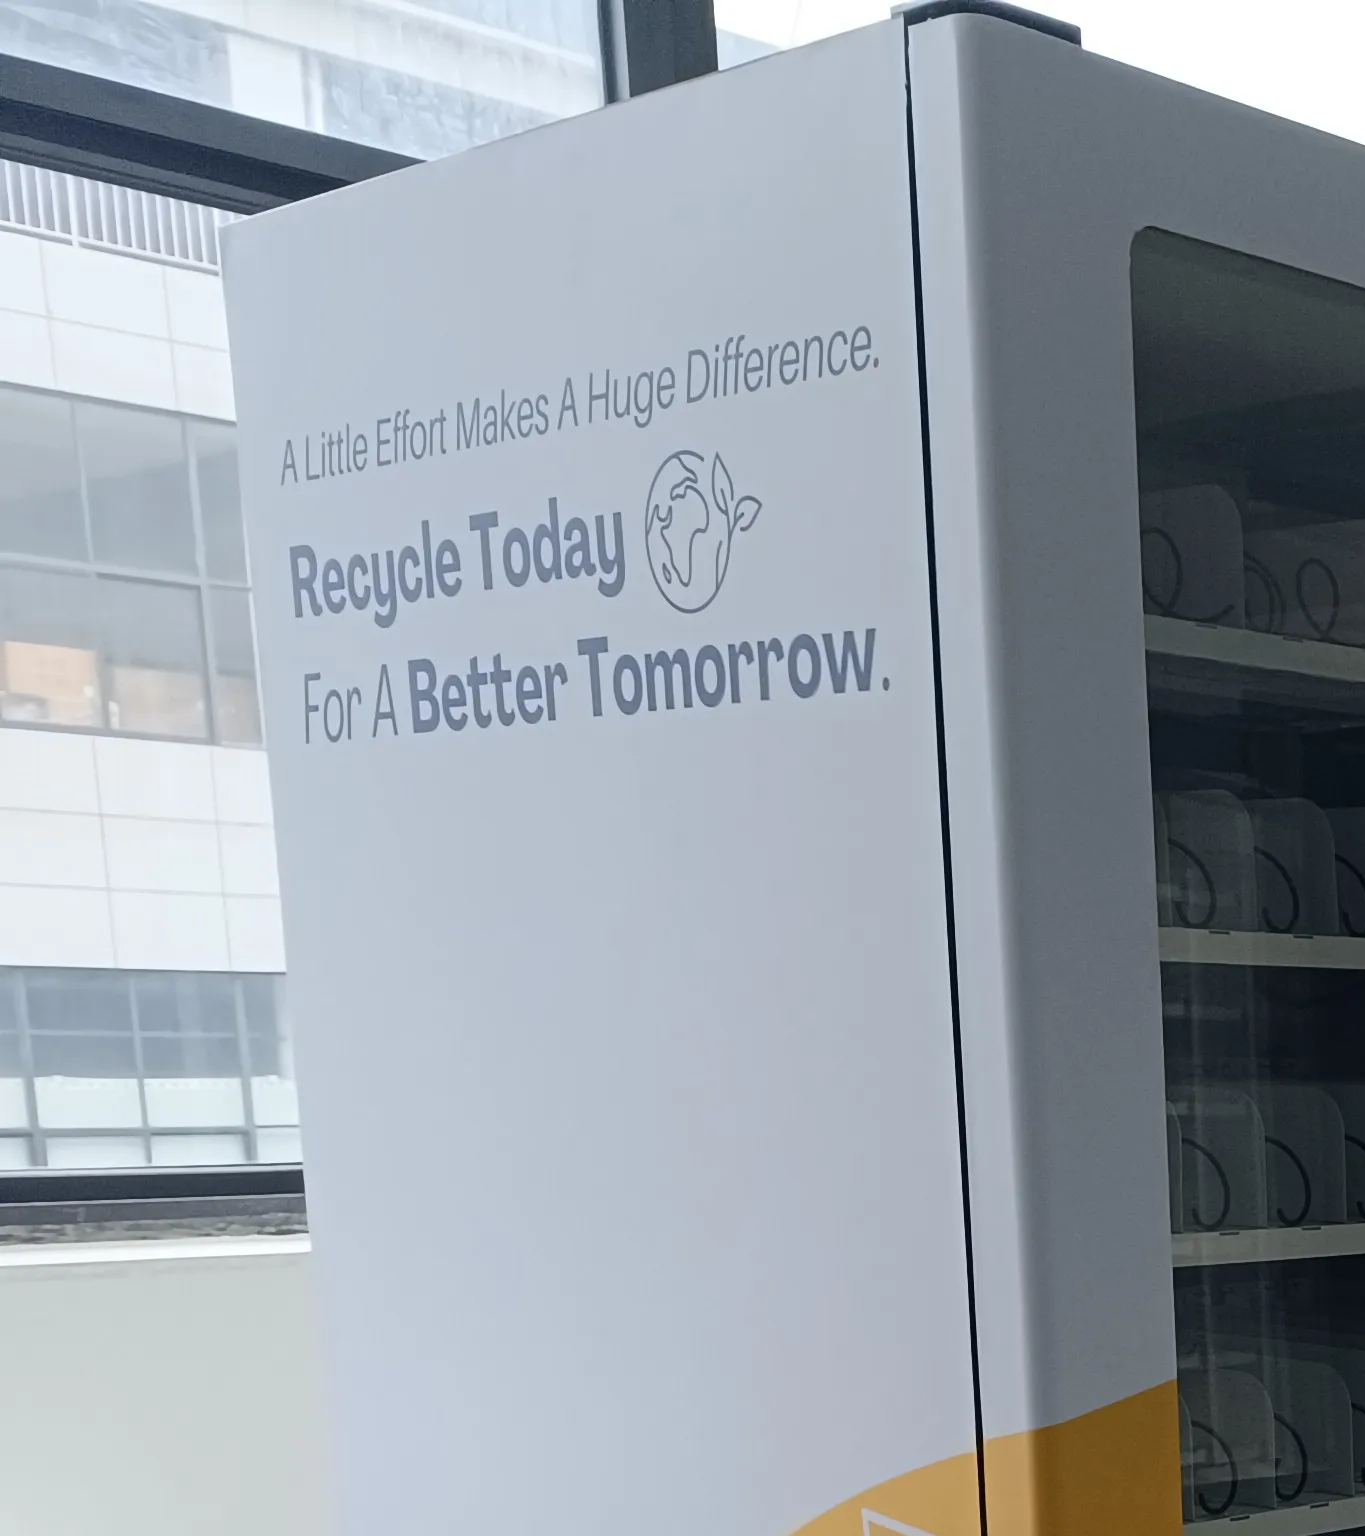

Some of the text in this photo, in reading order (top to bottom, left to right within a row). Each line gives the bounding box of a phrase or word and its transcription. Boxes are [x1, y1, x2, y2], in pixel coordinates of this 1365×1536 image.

[281, 325, 879, 486] A Little Effort Makes A Huge Difference.
[289, 497, 625, 629] Recycle Today
[304, 627, 890, 745] For A Better Tomorrow.
